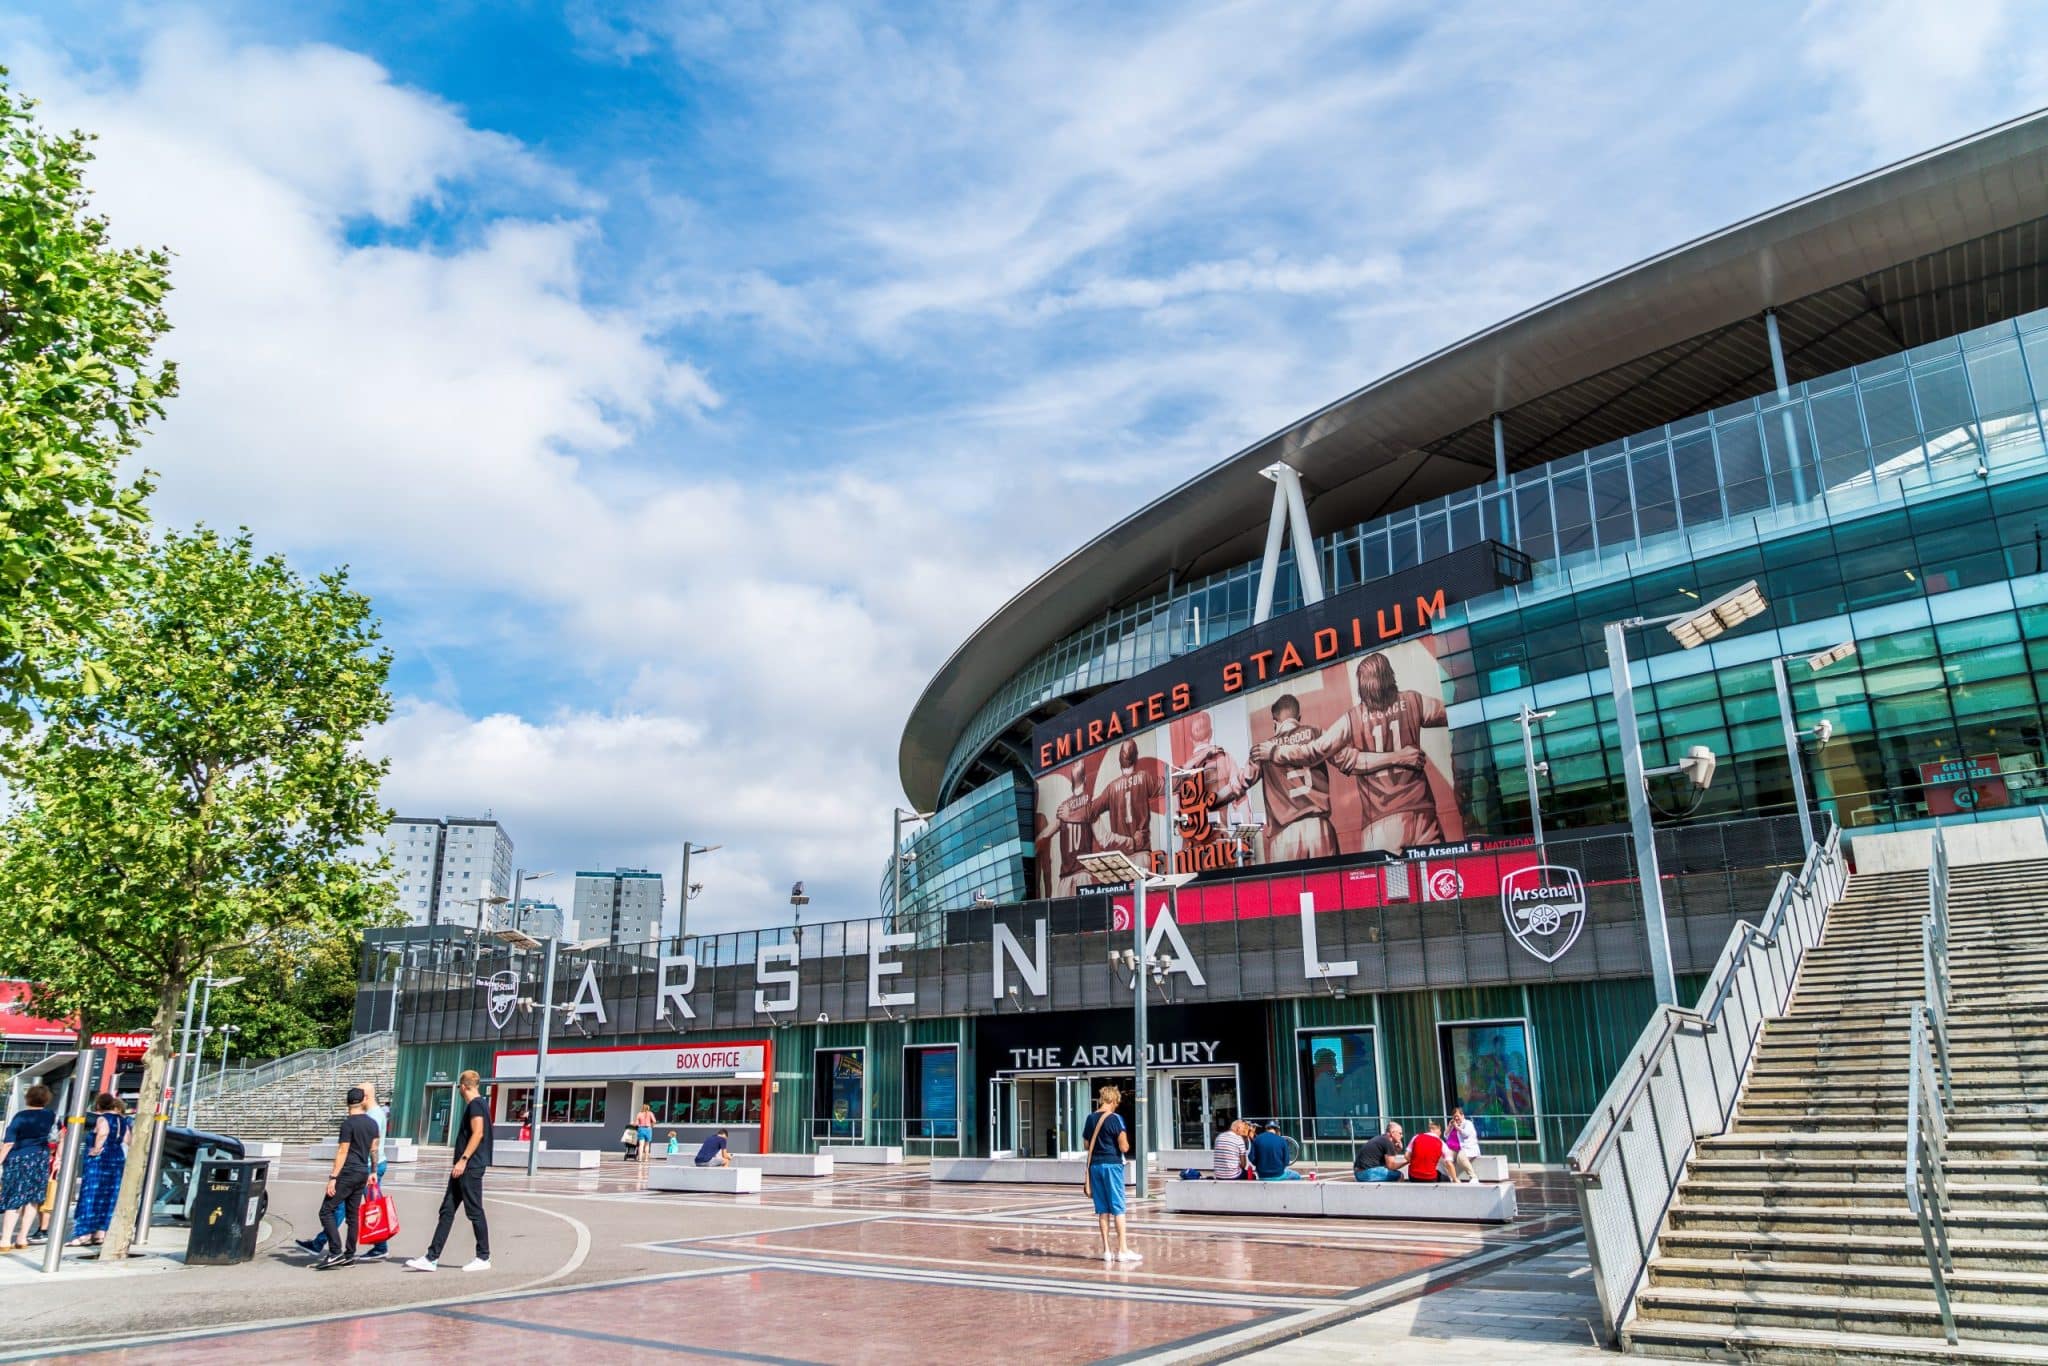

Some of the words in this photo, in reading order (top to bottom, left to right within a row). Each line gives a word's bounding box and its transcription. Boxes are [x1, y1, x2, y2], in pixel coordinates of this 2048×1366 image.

[1040, 682, 1191, 768] EMIRATES
[1223, 589, 1446, 692] STADIUM
[1372, 720, 1402, 776] 11
[1407, 849, 1427, 859] The
[1428, 843, 1468, 857] Arsenal
[1483, 837, 1535, 850] MATCHDAY
[1080, 888, 1095, 896] The
[1096, 883, 1127, 894] Arsenal
[1512, 882, 1573, 901] Arsenal
[91, 1036, 150, 1048] HAPMAN'S
[676, 1053, 699, 1069] BOX
[702, 1051, 740, 1068] OFFICE
[1009, 1047, 1061, 1067] THE
